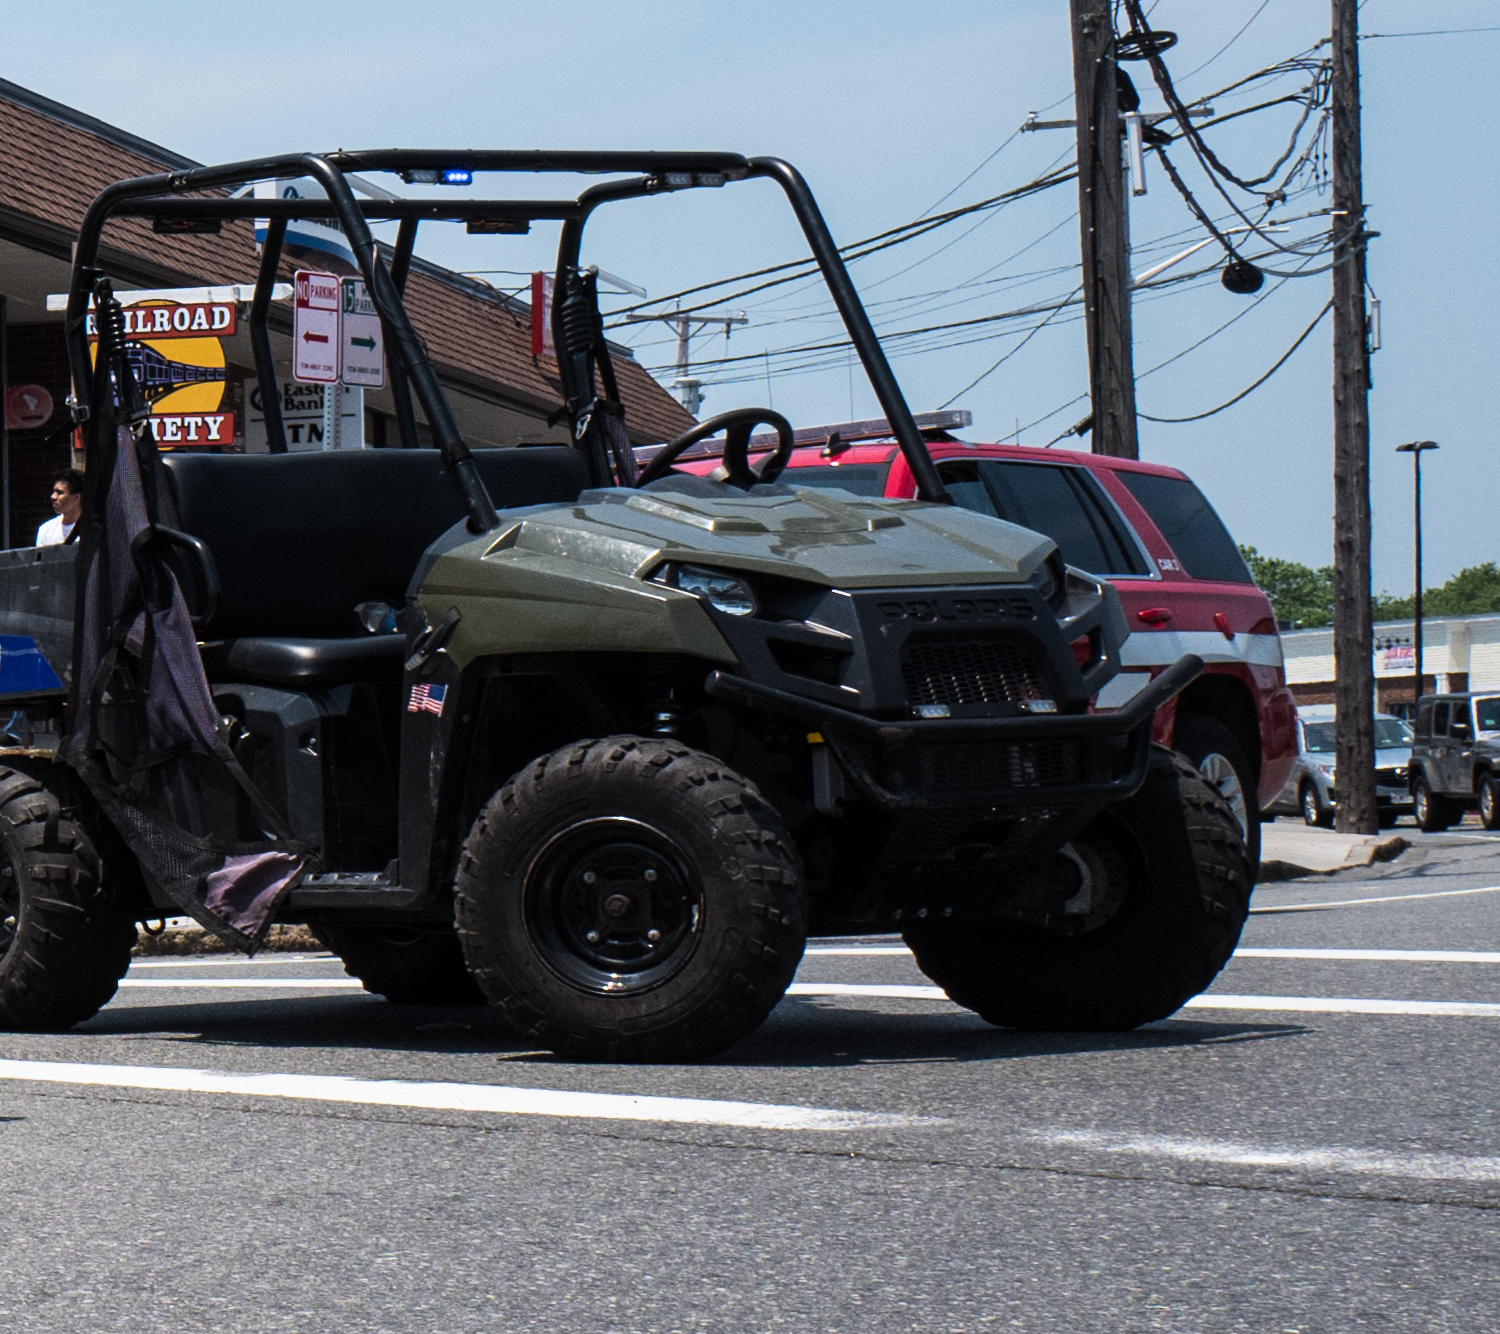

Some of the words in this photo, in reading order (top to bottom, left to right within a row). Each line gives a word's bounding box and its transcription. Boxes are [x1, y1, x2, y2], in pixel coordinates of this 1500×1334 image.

[297, 280, 308, 300] NO
[310, 285, 336, 300] PARKING
[343, 285, 354, 311] 15
[86, 307, 230, 334] RILROAD
[876, 598, 1035, 623] POLARIS
